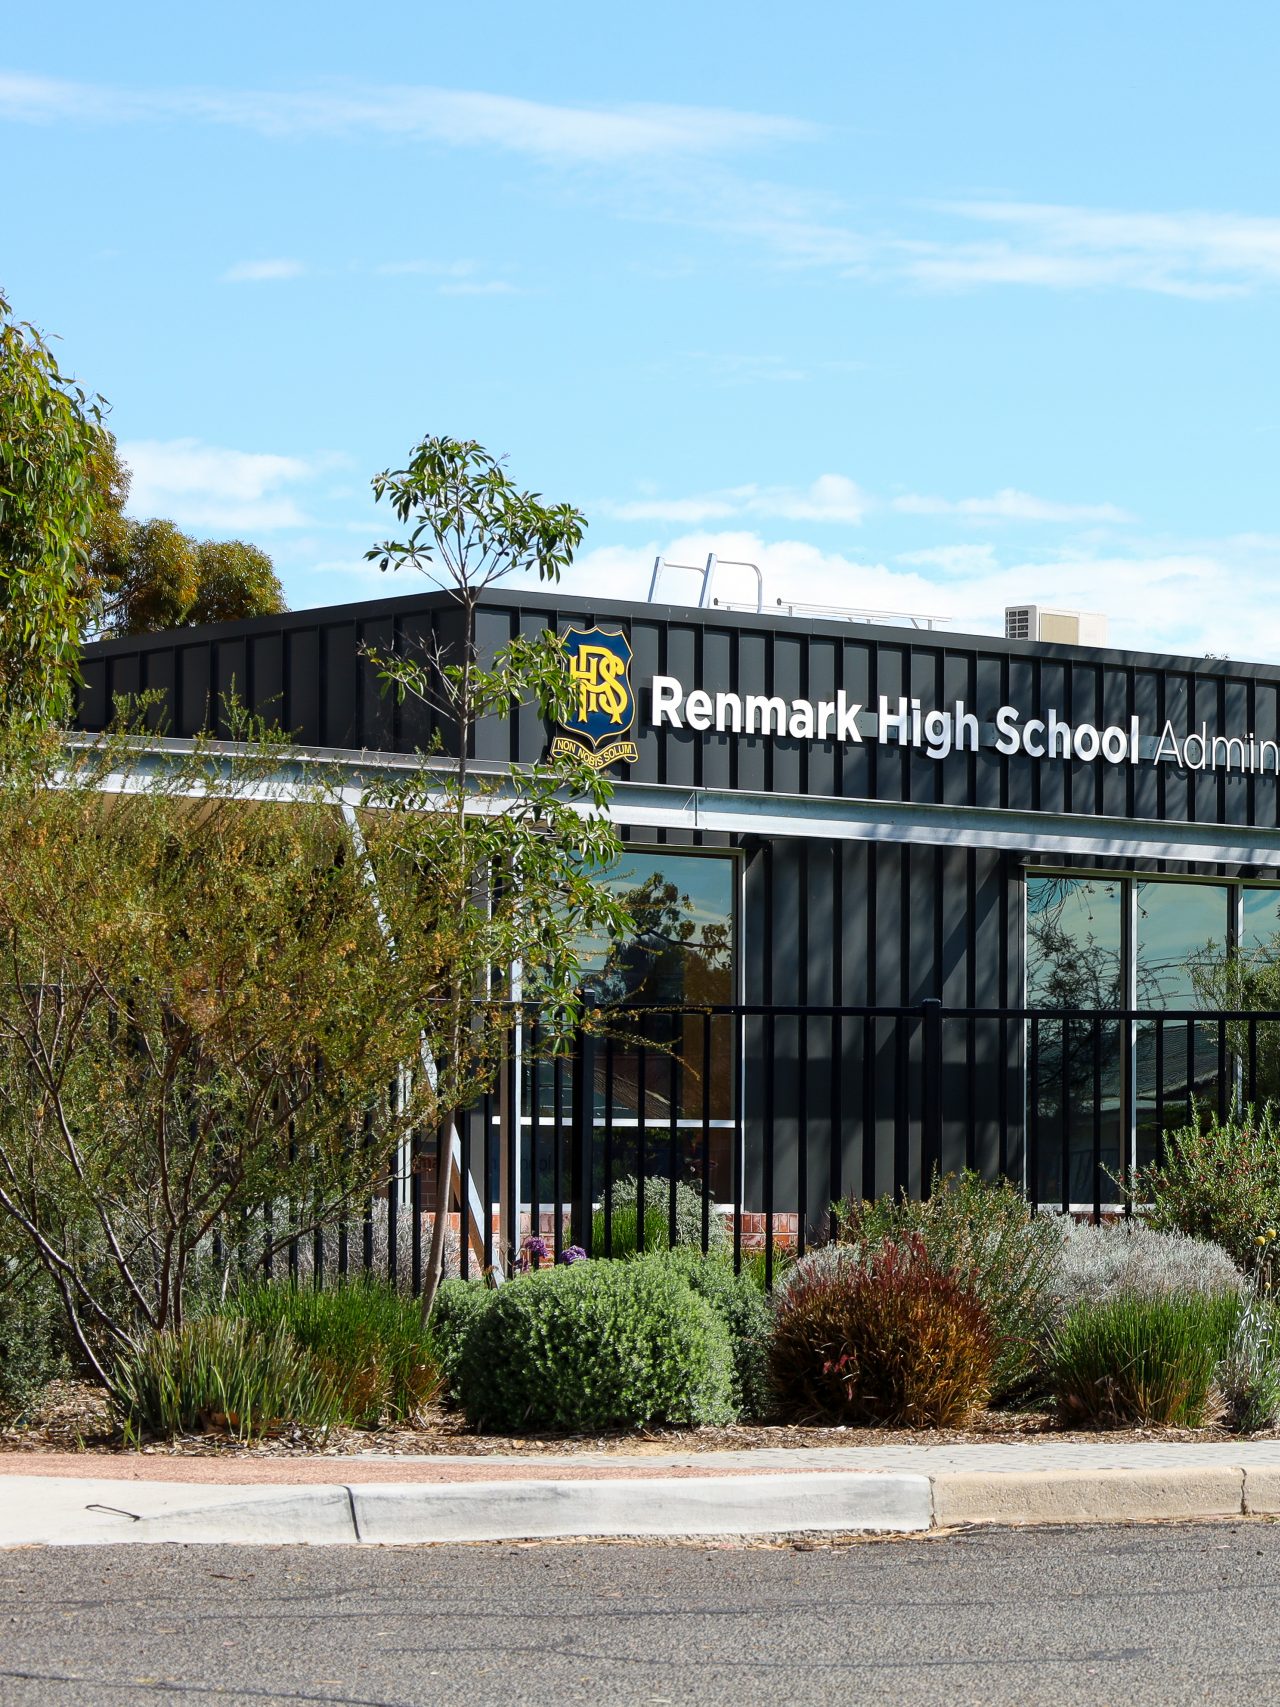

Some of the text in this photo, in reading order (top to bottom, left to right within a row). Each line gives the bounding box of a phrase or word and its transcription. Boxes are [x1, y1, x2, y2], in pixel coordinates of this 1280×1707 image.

[652, 675, 863, 743] Renmark
[878, 694, 980, 759] High
[993, 705, 1141, 765] School
[557, 740, 632, 766] NON NOBIS SOLUM
